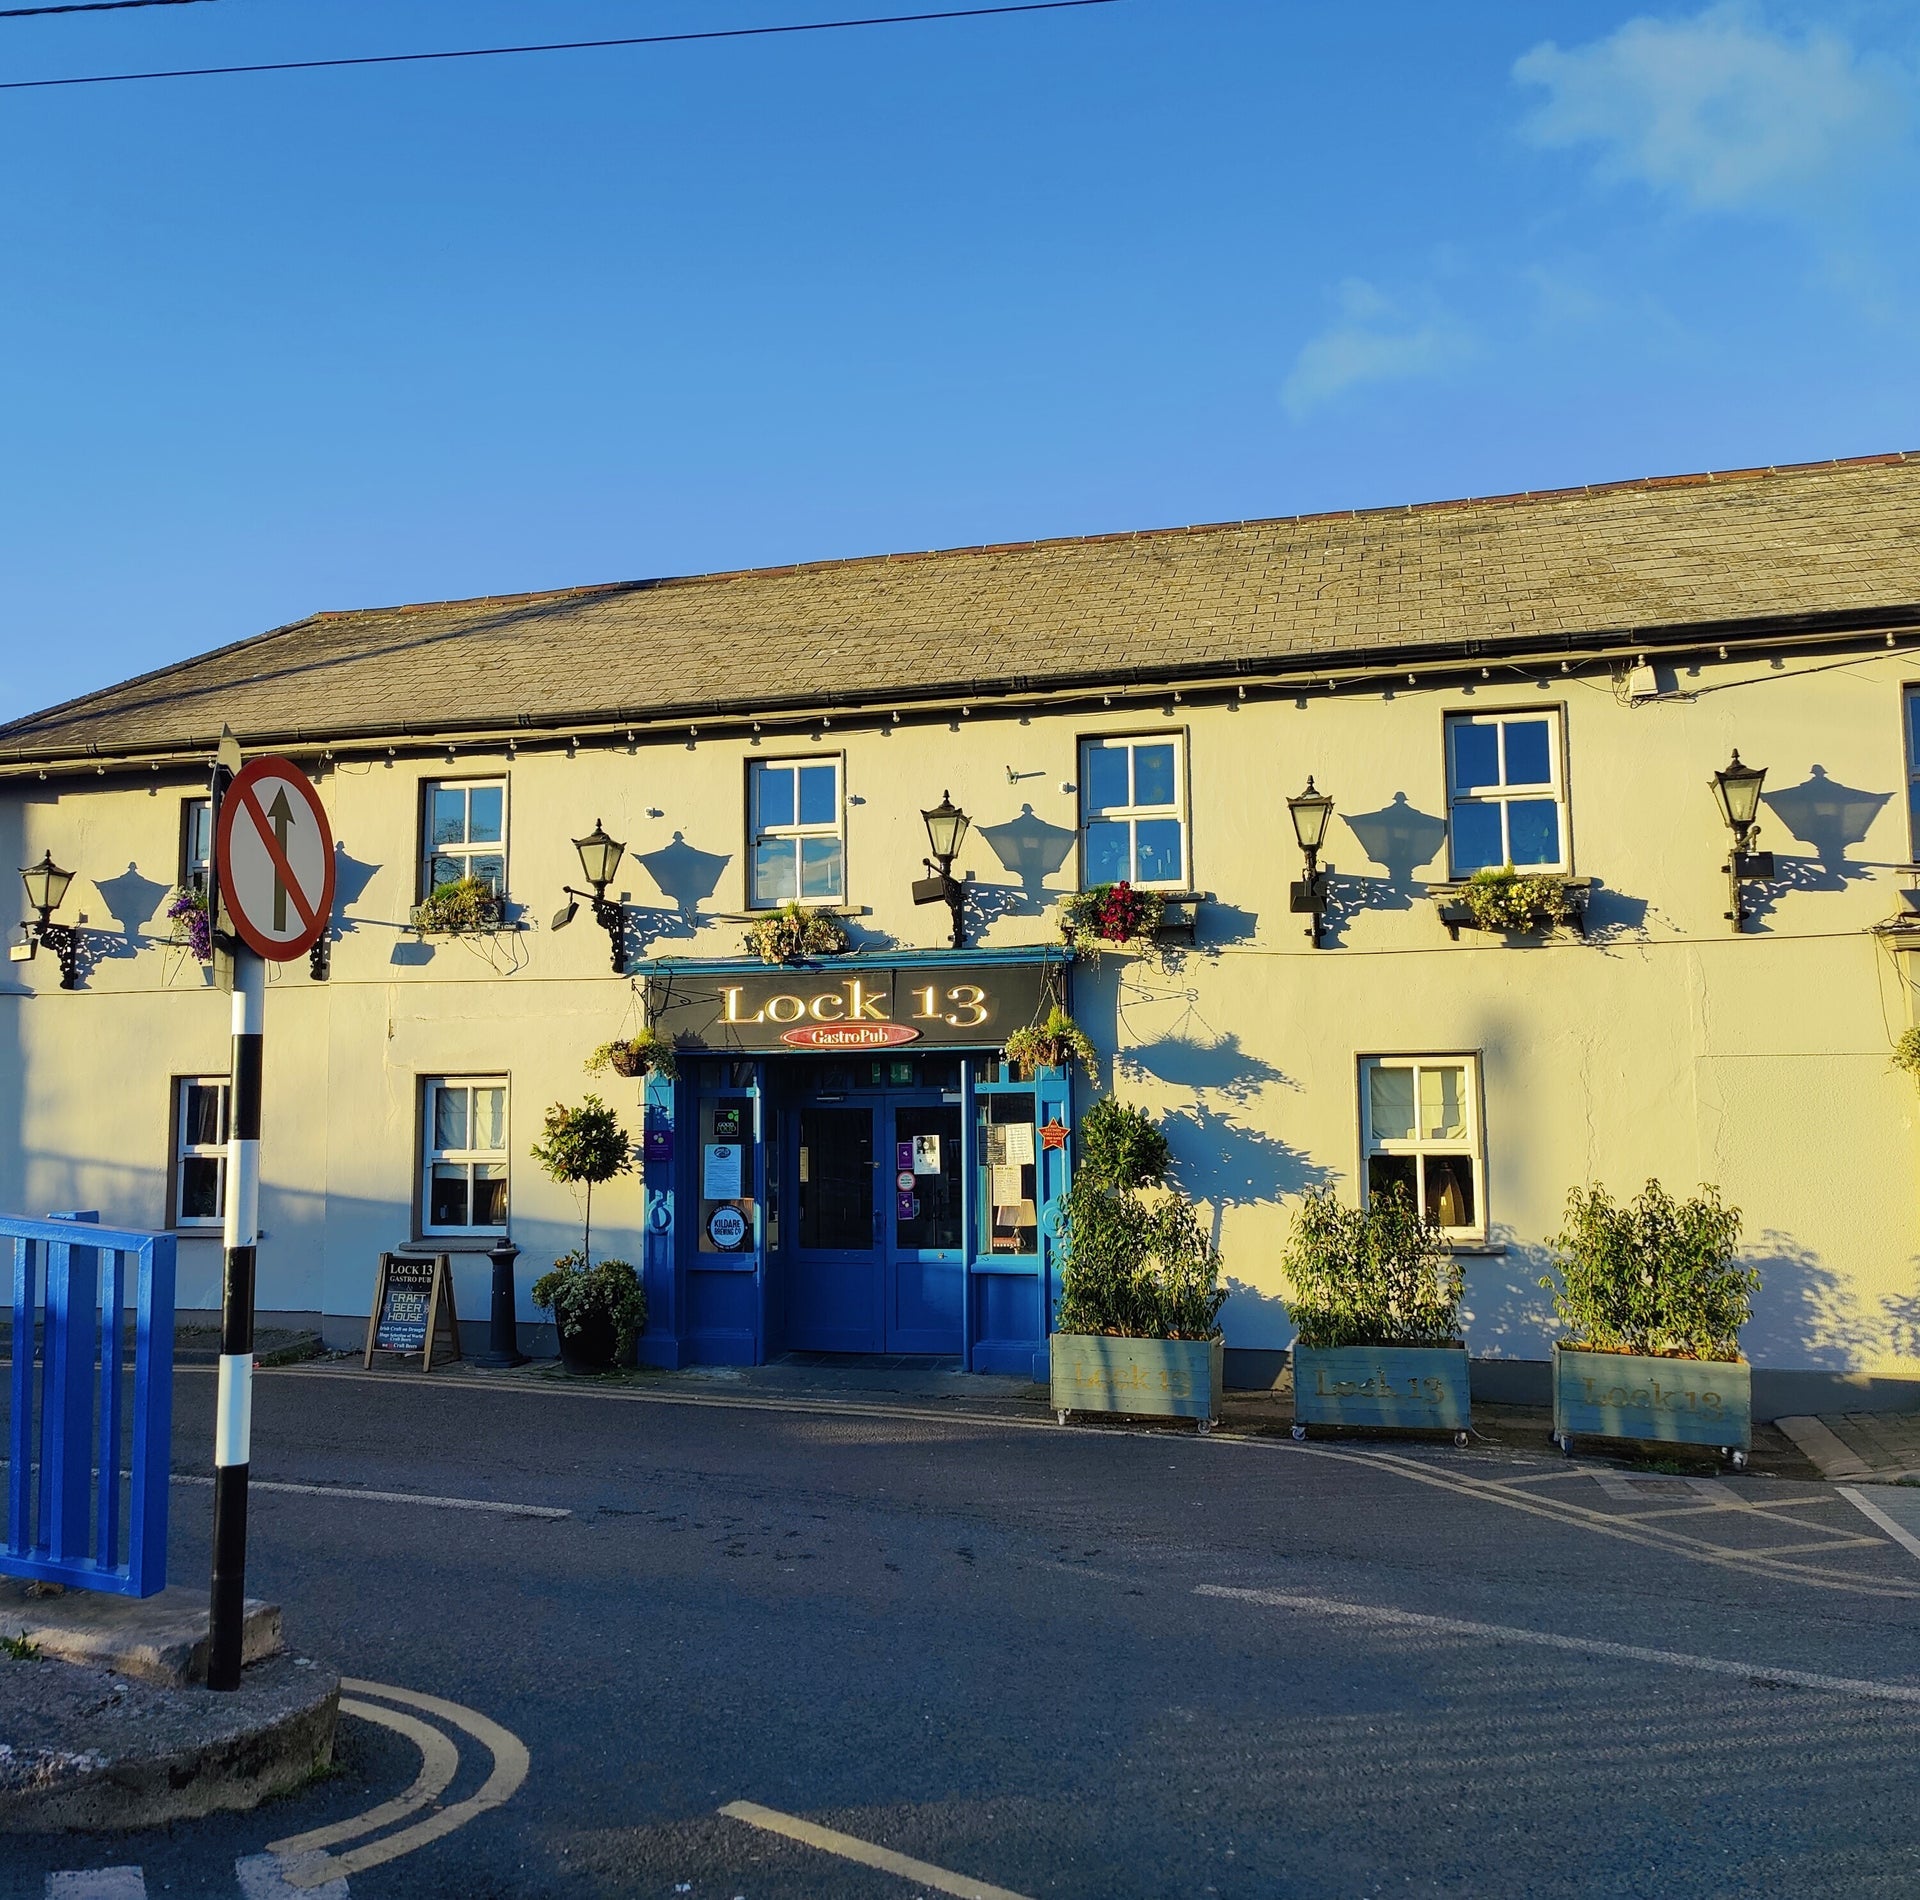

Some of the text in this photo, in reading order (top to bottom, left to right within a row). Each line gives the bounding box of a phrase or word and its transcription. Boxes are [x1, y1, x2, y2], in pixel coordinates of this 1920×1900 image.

[717, 980, 988, 1026] Lock 13
[812, 1028, 888, 1044] GastroPub
[714, 1219, 741, 1228] KILDARE
[390, 1264, 433, 1275] LOCK 13
[391, 1294, 426, 1303] CRAFT
[393, 1303, 422, 1313] BEER
[387, 1312, 423, 1322] HOUSE
[1407, 1377, 1445, 1404] 13
[1582, 1377, 1725, 1422] Lock 13
